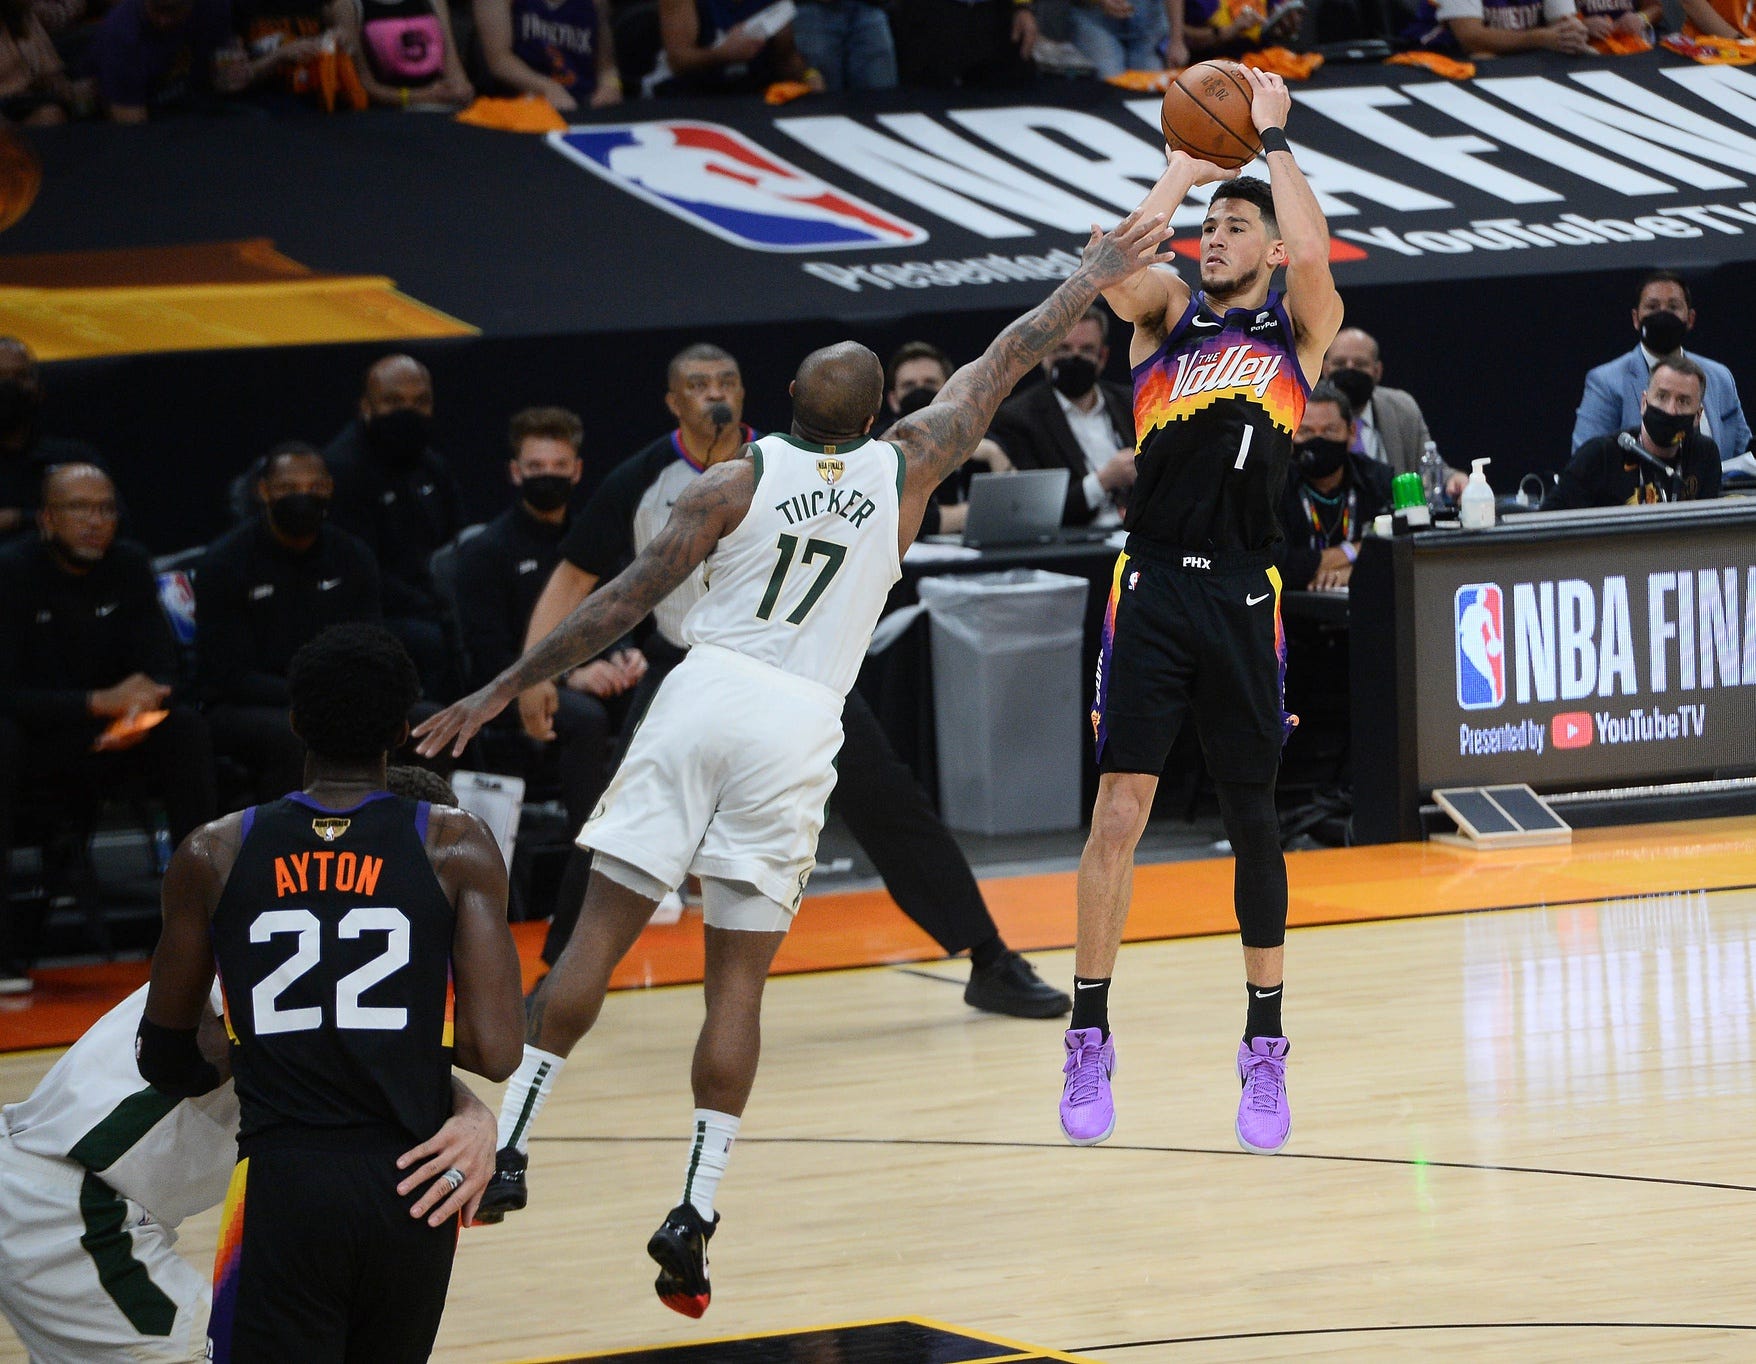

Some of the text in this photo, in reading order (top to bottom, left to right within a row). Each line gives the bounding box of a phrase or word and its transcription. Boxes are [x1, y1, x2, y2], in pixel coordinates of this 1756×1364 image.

[1250, 320, 1278, 332] PayPal
[1168, 344, 1283, 402] Valley
[1199, 351, 1221, 364] THE
[1234, 424, 1254, 470] 1
[775, 488, 876, 529] TUCKER
[755, 532, 849, 627] 17
[1182, 556, 1212, 570] PHX
[1513, 574, 1638, 704] NBA
[274, 850, 383, 898] AYTON
[249, 906, 411, 1036] 22
